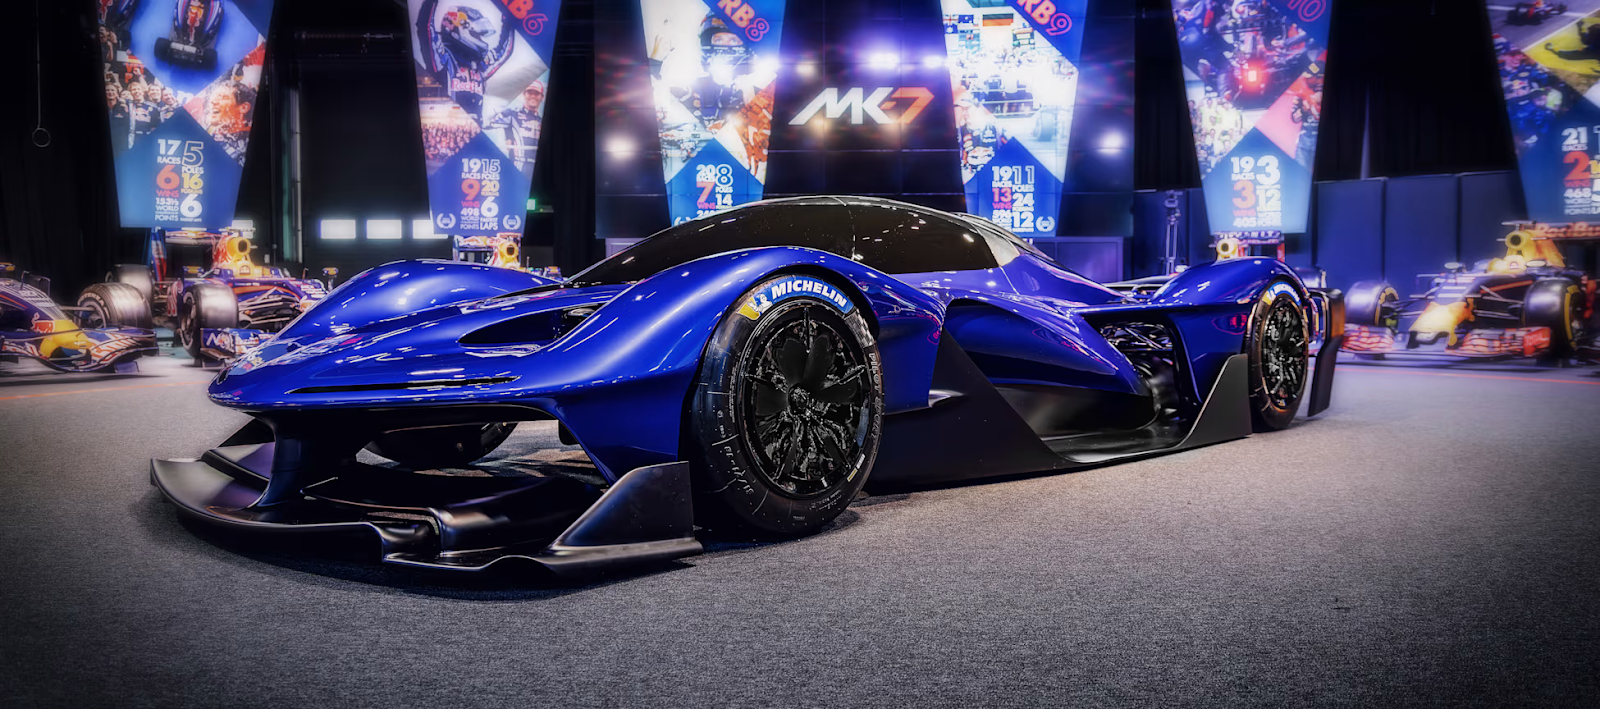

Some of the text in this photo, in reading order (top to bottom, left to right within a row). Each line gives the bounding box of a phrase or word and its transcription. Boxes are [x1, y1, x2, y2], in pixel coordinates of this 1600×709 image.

[1561, 126, 1588, 145] 21
[157, 139, 181, 155] 17
[182, 140, 204, 167] 5
[181, 166, 204, 174] POLES
[462, 158, 482, 173] 19
[482, 159, 501, 174] 15
[1230, 156, 1255, 173] 19
[1256, 155, 1281, 185] 3
[1562, 151, 1591, 181] 2
[156, 164, 180, 190] 6
[181, 173, 204, 189] 16
[715, 164, 734, 187] 8
[992, 166, 1013, 181] 19
[1012, 165, 1035, 184] 11
[461, 178, 481, 201] 9
[481, 179, 500, 192] 20
[696, 181, 716, 203] 7
[1012, 184, 1035, 193] POLES
[715, 193, 734, 206] 14
[992, 187, 1013, 203] 13
[1012, 192, 1035, 207] 24
[1232, 180, 1256, 209] 3
[1256, 189, 1281, 212] 12
[180, 193, 203, 218] 6
[480, 196, 499, 218] 6
[696, 201, 716, 210] WINS
[480, 222, 498, 230] LAPS
[1012, 211, 1035, 228] 12
[771, 279, 848, 308] MICHELIN
